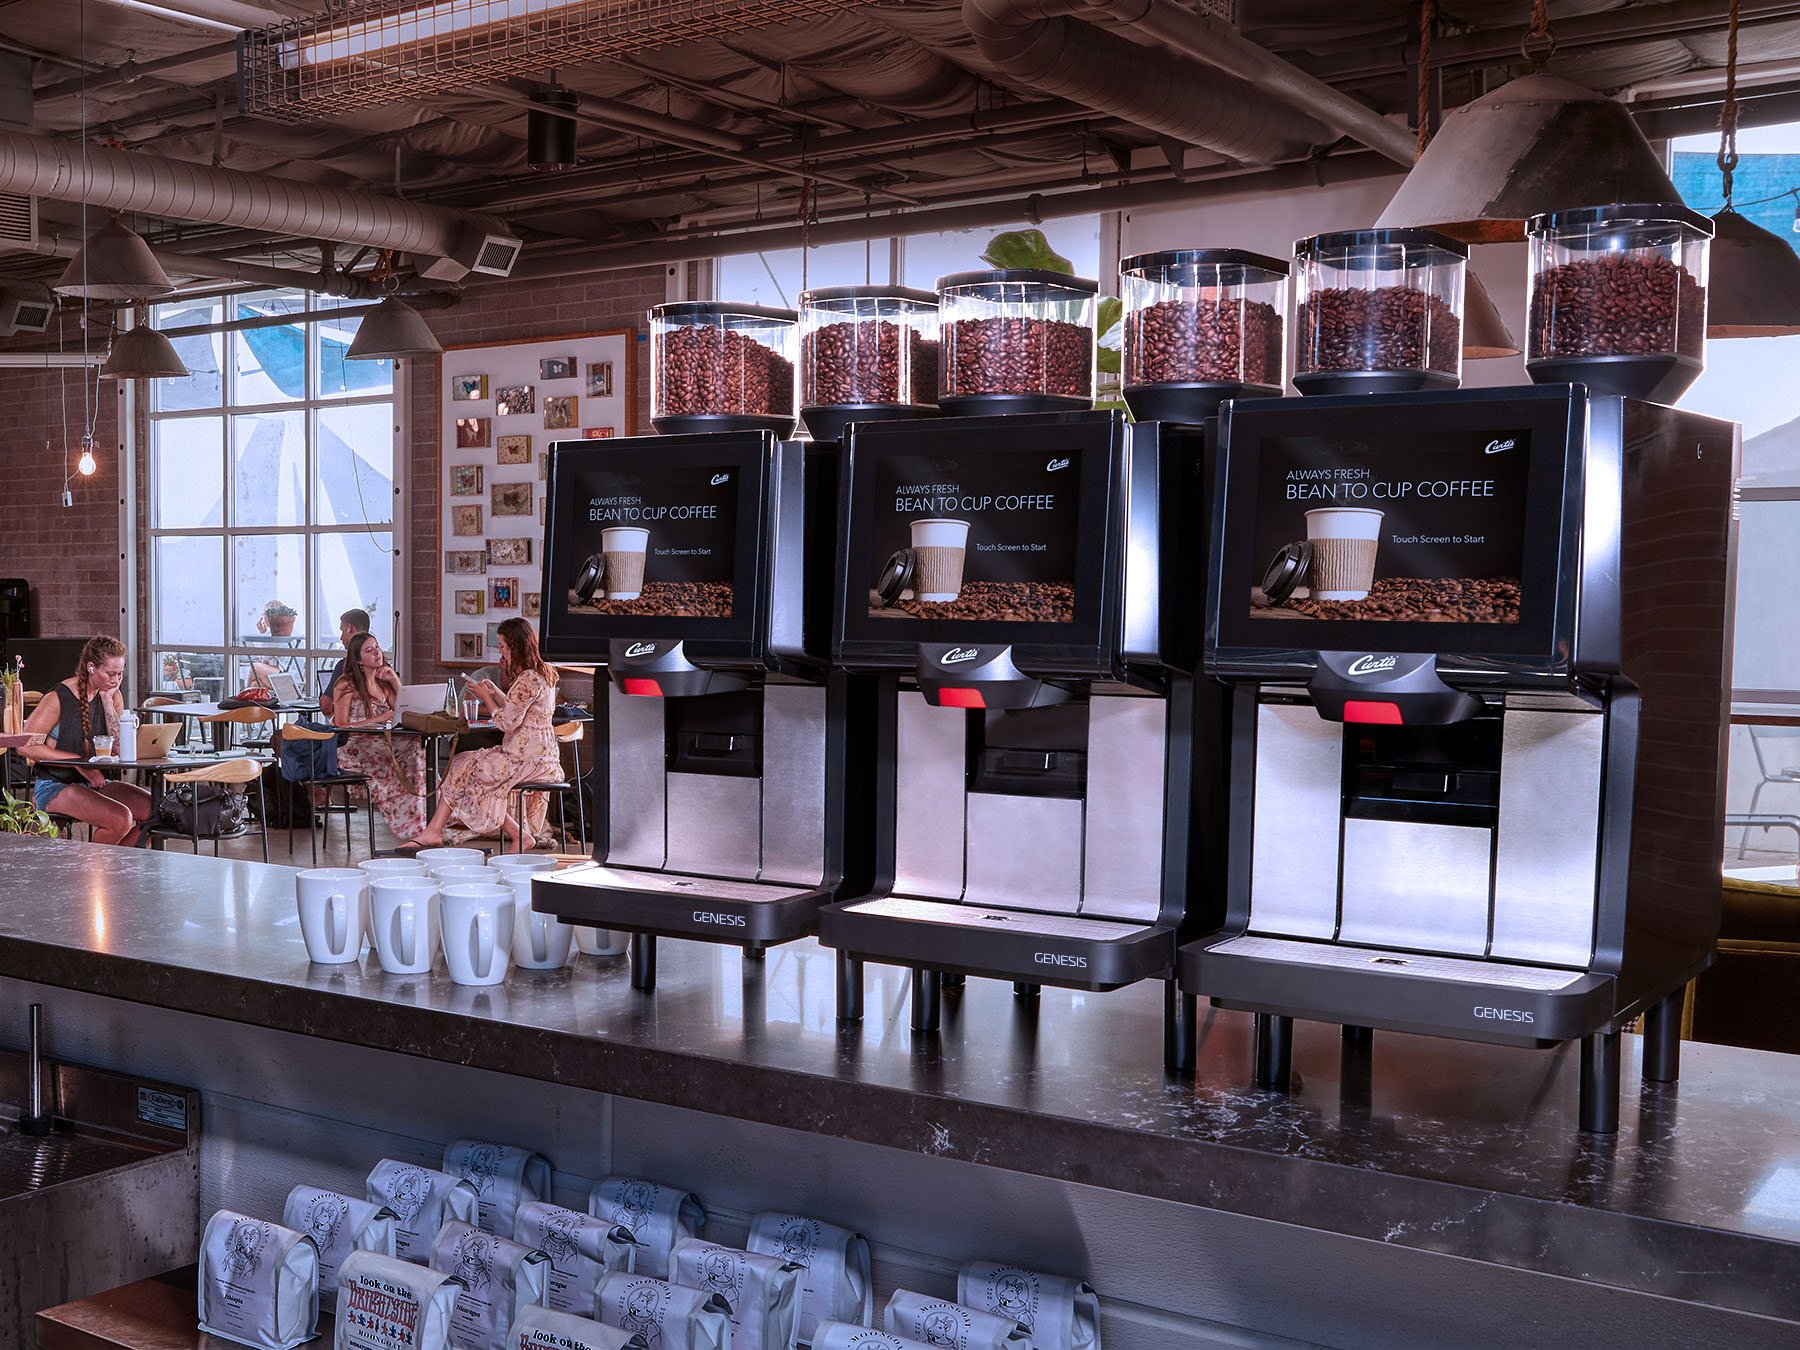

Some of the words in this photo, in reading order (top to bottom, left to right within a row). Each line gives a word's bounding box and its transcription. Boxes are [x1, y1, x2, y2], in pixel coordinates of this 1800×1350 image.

[1485, 439, 1516, 454] Curtis
[1047, 458, 1070, 471] Curtis
[1287, 470, 1331, 481] ALWAYS
[1334, 469, 1370, 479] FRESH
[896, 485, 930, 495] ALWAYS
[932, 484, 960, 494] FRESH
[1286, 484, 1335, 500] BEAN
[1341, 483, 1368, 499] TO
[1372, 482, 1412, 498] CUP
[1417, 480, 1494, 498] COFFEE
[589, 497, 617, 506] ALWAYS
[618, 497, 641, 505] FRESH
[895, 497, 934, 512] BEAN
[939, 497, 958, 511] TO
[961, 496, 992, 511] CUP
[995, 495, 1054, 511] COFFEE
[589, 508, 621, 521] BEAN
[624, 507, 640, 520] TO
[642, 507, 667, 520] CUP
[669, 505, 717, 520] COFFEE
[976, 543, 996, 552] Touch
[997, 543, 1021, 552] Screen
[1022, 543, 1029, 552] to
[1030, 543, 1047, 552] Start
[1392, 535, 1418, 544] Touch
[1420, 535, 1450, 544] Screen
[1452, 536, 1462, 544] to
[1464, 535, 1485, 544] Start
[671, 548, 690, 556] Screen
[625, 642, 657, 658] Curtis
[940, 647, 979, 665] Curtis
[1348, 655, 1399, 675] Curtis
[693, 911, 746, 927] GENESIS
[1034, 952, 1087, 968] GENESIS
[1473, 1006, 1534, 1023] GENESIS
[360, 1274, 381, 1290] look
[383, 1284, 395, 1295] on
[397, 1287, 412, 1301] the
[920, 1303, 972, 1328] MOONGOAT
[533, 1329, 557, 1344] look
[559, 1338, 573, 1350] on
